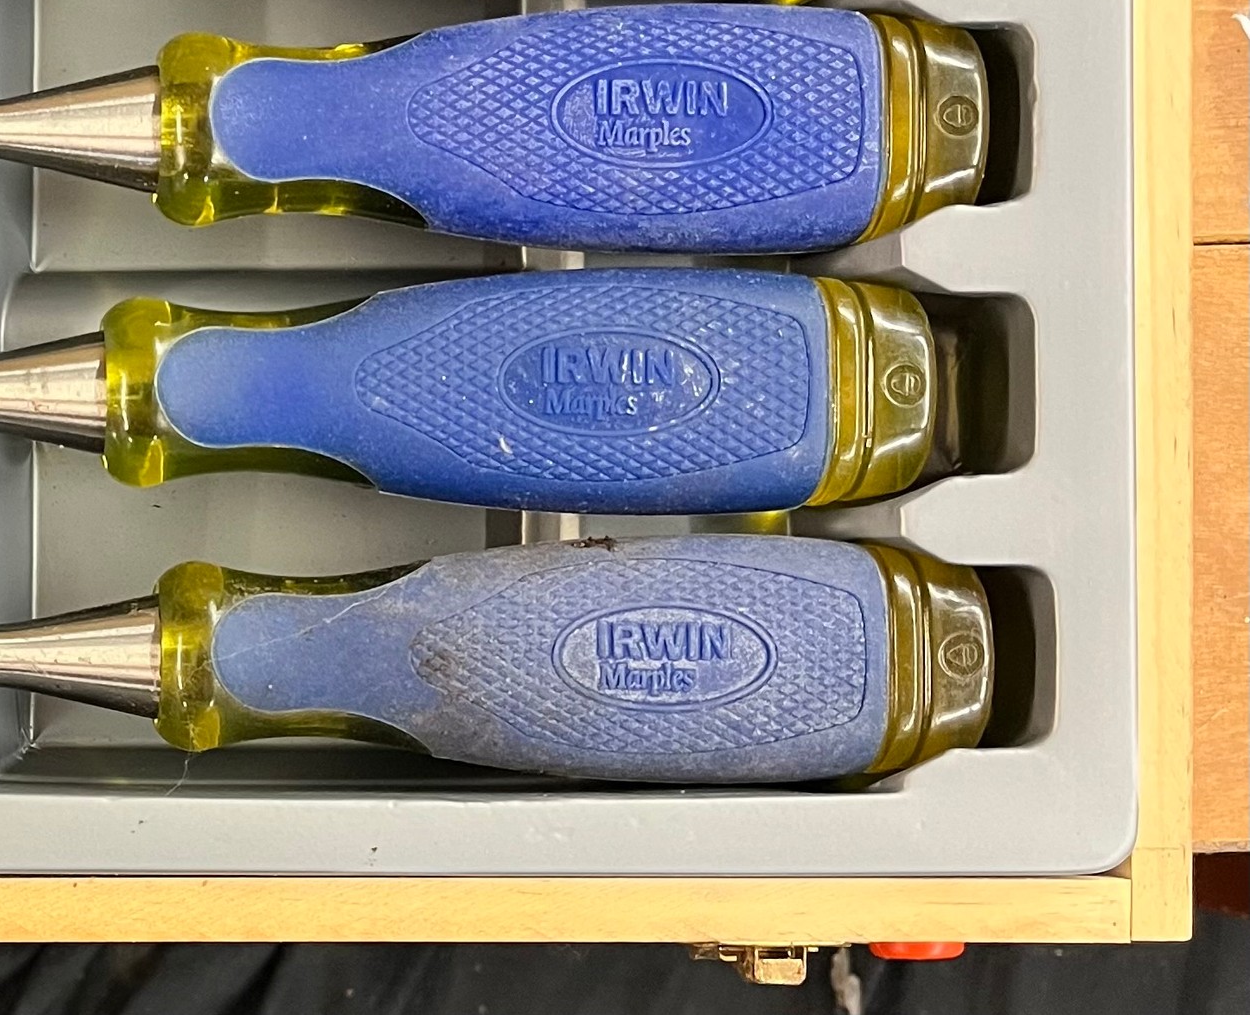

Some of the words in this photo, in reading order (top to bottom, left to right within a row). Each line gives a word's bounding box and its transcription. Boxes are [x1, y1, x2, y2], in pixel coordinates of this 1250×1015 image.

[595, 79, 729, 117] IRWIN
[597, 119, 692, 153] Marples
[540, 344, 675, 387] IRWIN
[544, 388, 638, 422] Marples
[596, 619, 732, 661] IRWIN
[598, 662, 696, 696] Marples
